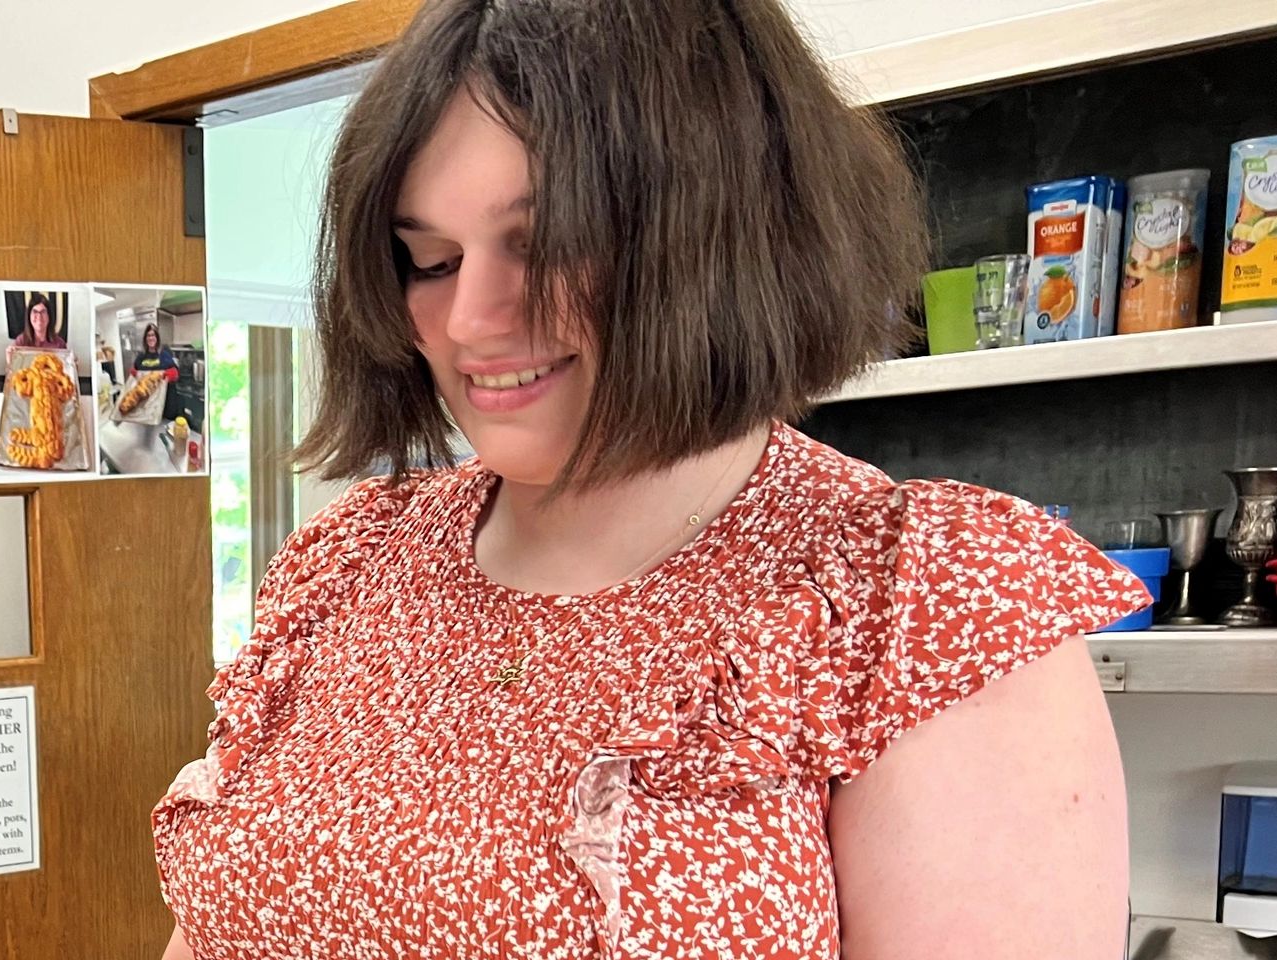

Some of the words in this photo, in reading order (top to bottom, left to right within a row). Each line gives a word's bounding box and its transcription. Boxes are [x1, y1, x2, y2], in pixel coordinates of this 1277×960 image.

[1040, 221, 1078, 237] ORANGE
[3, 814, 27, 827] pots,
[2, 828, 24, 839] with
